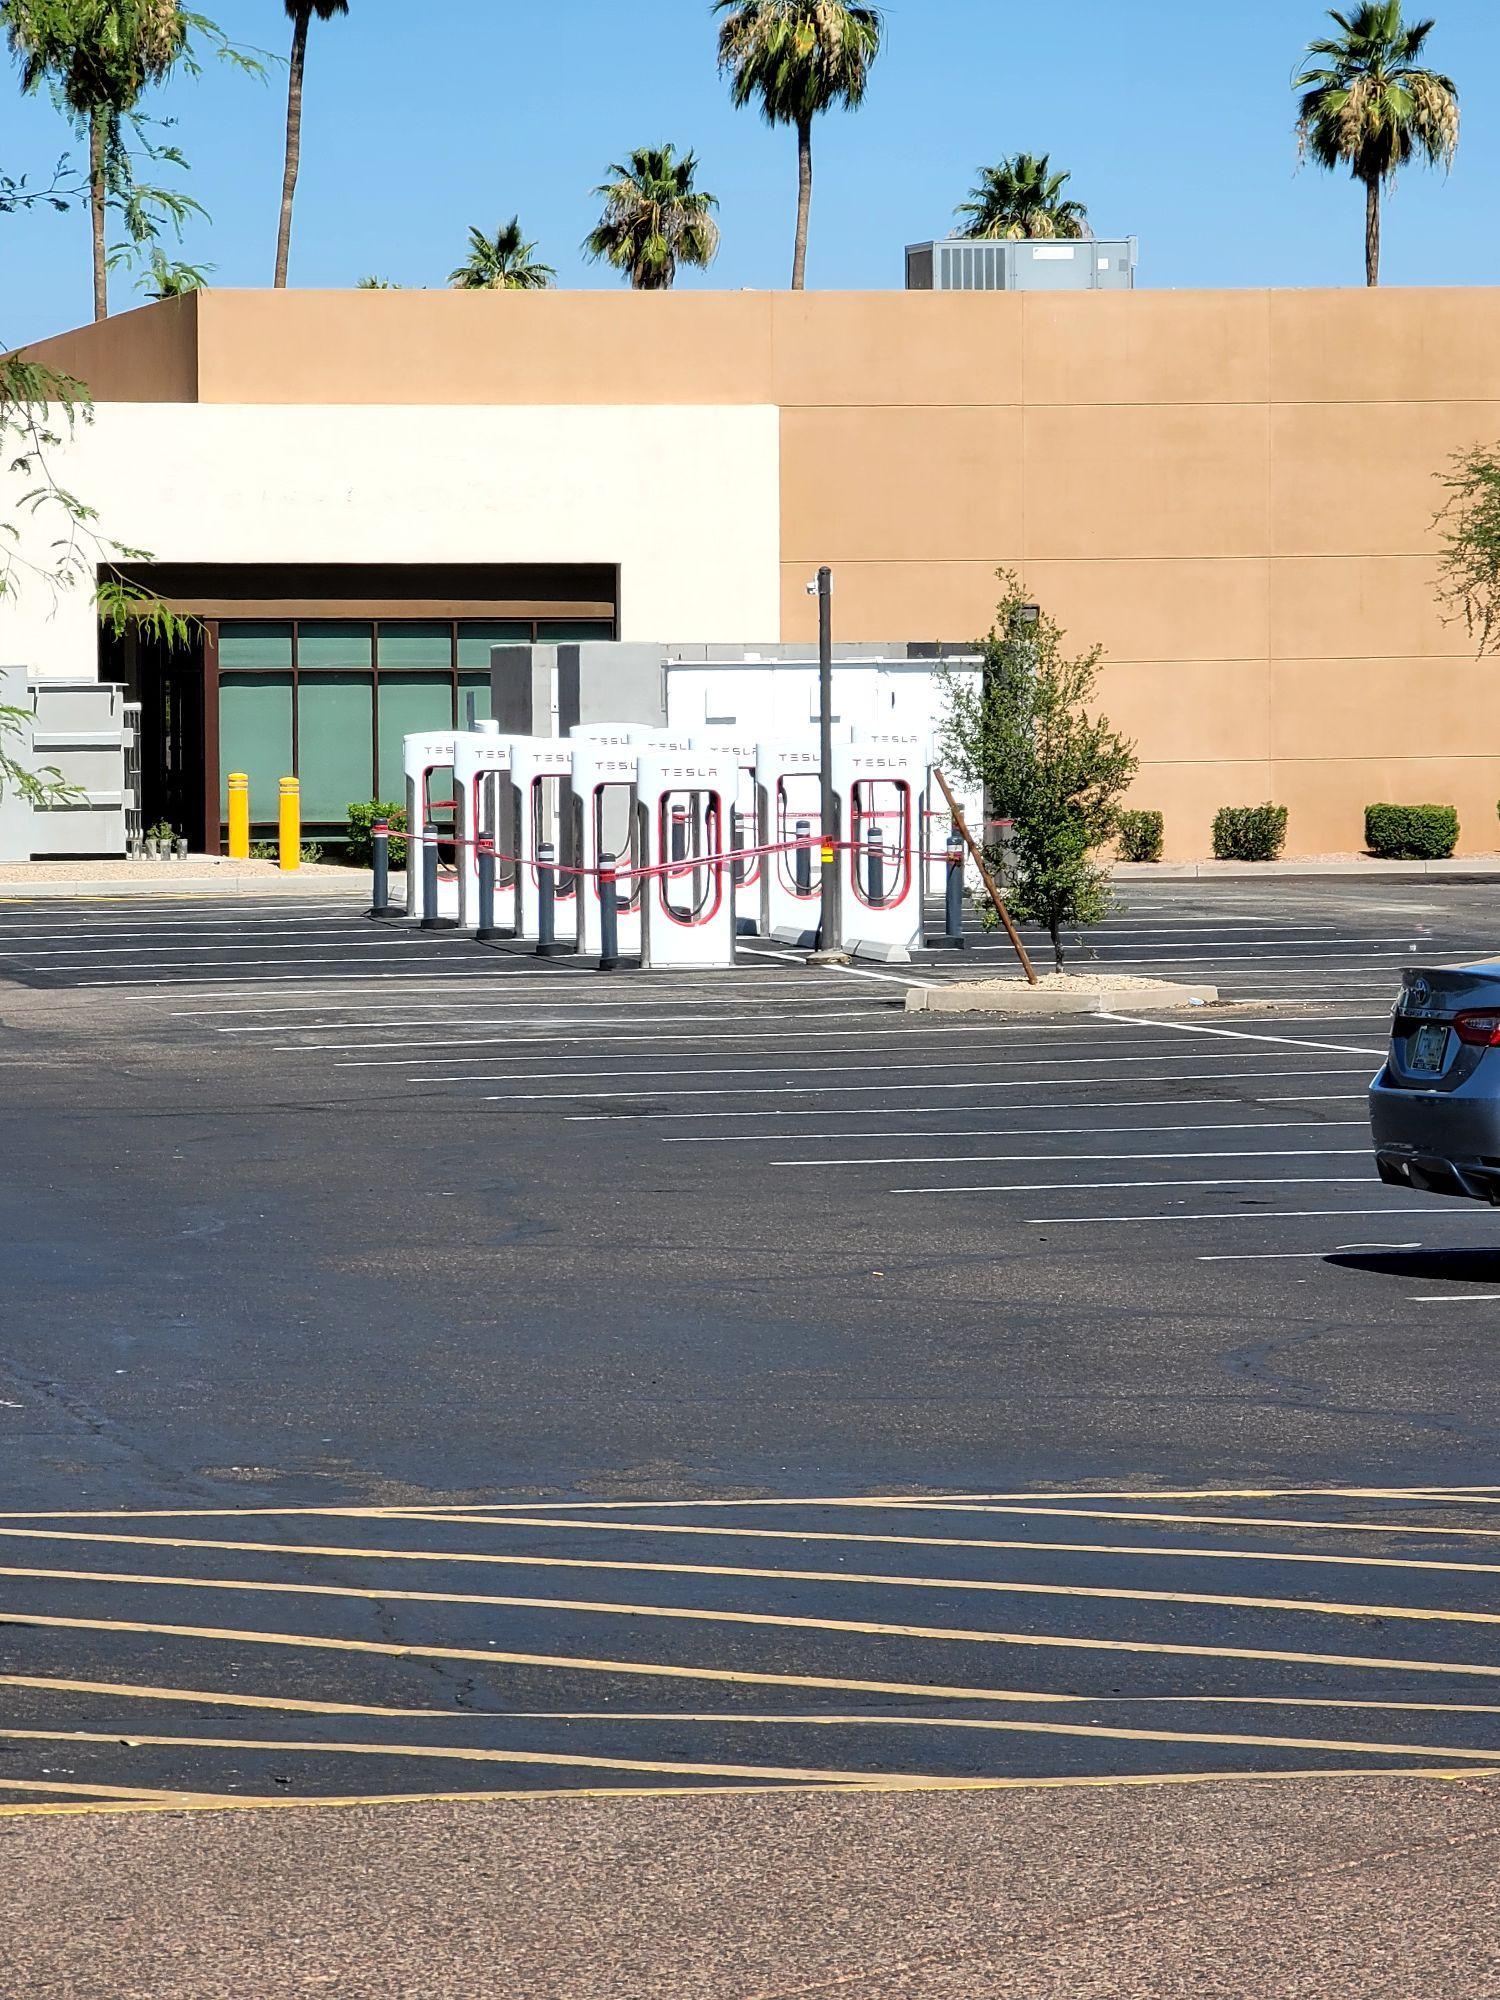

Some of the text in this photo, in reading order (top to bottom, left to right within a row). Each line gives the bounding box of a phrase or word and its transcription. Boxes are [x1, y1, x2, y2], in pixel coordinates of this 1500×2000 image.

[871, 735, 917, 743] TESLA
[424, 746, 454, 754] TES
[475, 750, 511, 759] TES
[533, 754, 573, 762] TESL
[779, 753, 821, 762] TESL
[595, 761, 638, 770] TESL
[853, 759, 907, 767] TESLA
[660, 768, 718, 777] TESLA
